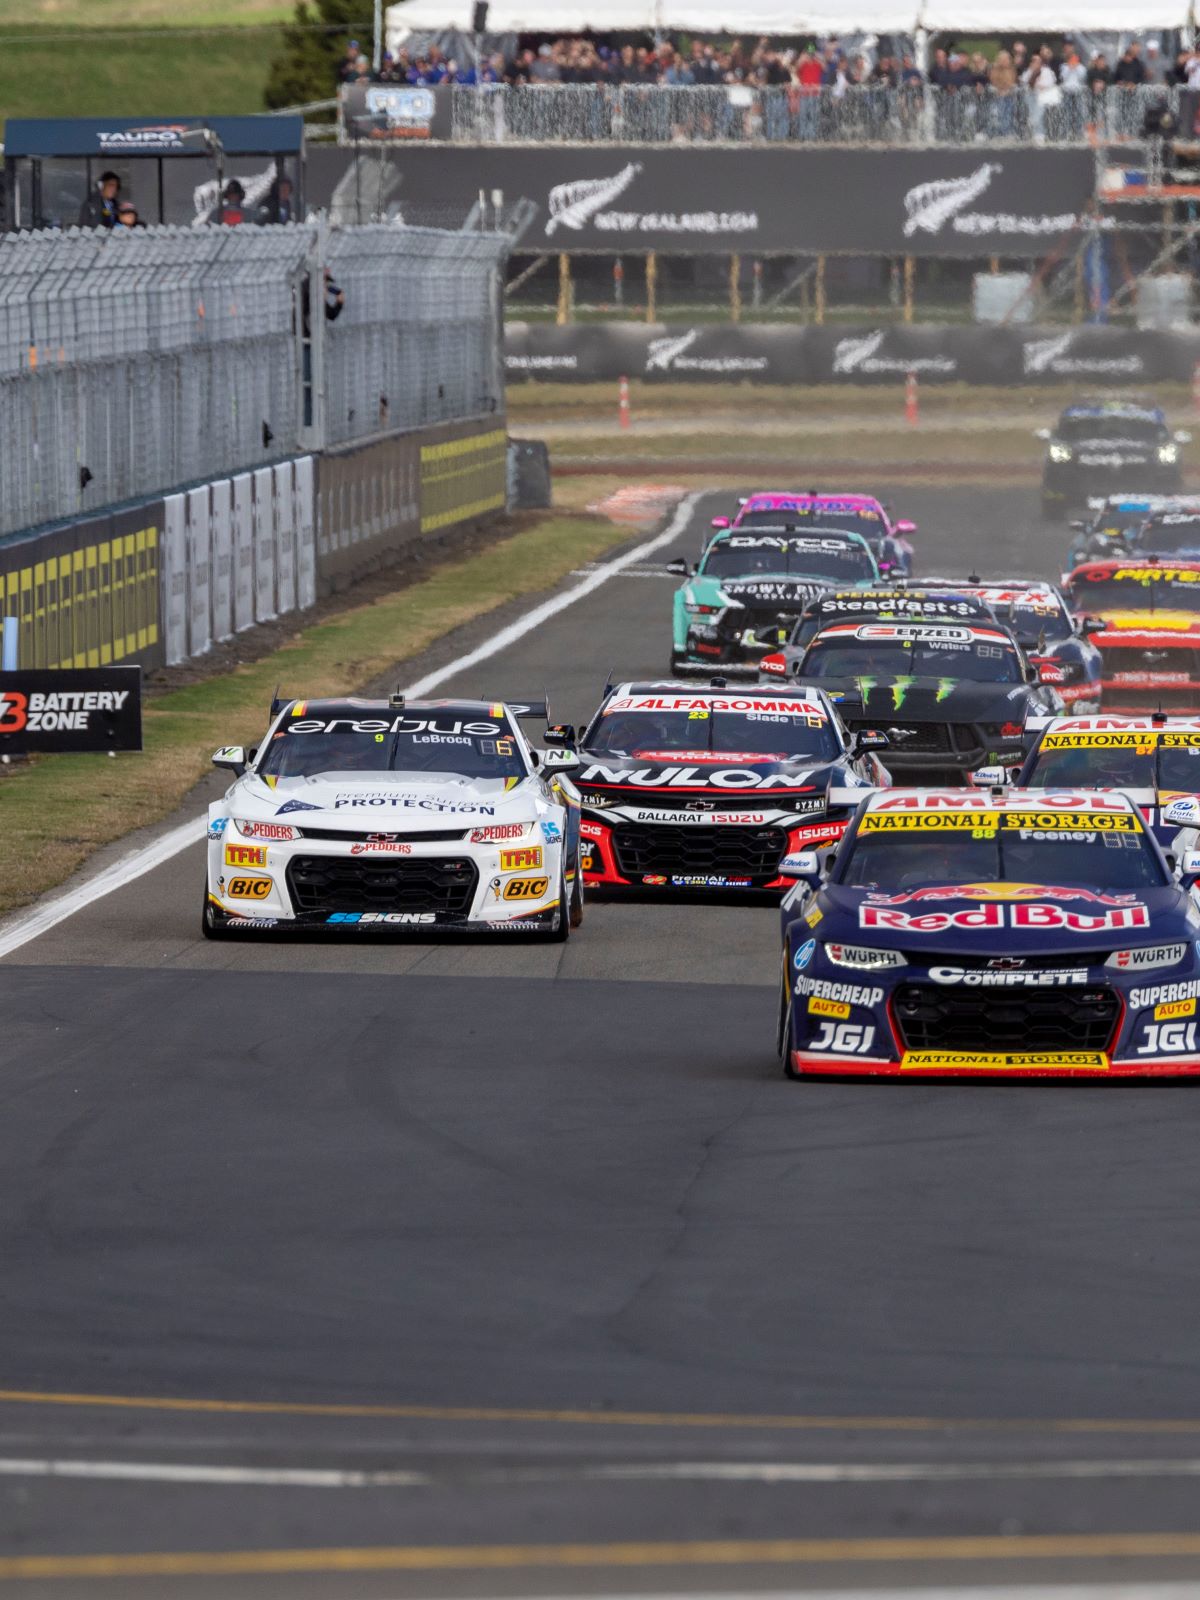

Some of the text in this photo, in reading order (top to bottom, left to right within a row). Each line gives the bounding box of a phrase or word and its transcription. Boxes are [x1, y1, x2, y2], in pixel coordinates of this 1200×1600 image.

[729, 537, 848, 549] DAYCO
[822, 600, 946, 613] Steadfast
[897, 627, 962, 638] ENZED
[929, 641, 970, 652] Waters
[28, 691, 130, 711] BATTERY
[634, 699, 823, 715] ALFAGOMMA
[25, 711, 91, 732] ZONE
[688, 711, 788, 723] 23 Slade
[288, 716, 500, 736] erebus
[374, 734, 472, 748] 9 LeBrocq
[1045, 735, 1151, 748] NATIONAL
[582, 766, 815, 788] NULON
[335, 799, 494, 815] PROTECTION
[876, 795, 1127, 810] AMPOL
[637, 811, 764, 823] BALLARAT ISUZU
[863, 812, 1130, 832] NATIONAL STORAGE
[254, 823, 293, 840] PEDDERS
[484, 824, 523, 840] PEDDERS
[799, 826, 840, 839] ISUZU
[972, 829, 1097, 843] 88 Feeney
[227, 846, 261, 863] TFH
[365, 843, 412, 854] PEDDERS
[503, 850, 537, 867] TFH
[859, 904, 1151, 932] Red Bull
[844, 947, 898, 966] WÜRTH
[1132, 945, 1183, 964] WÜRTH
[928, 966, 1088, 986] COMPLETE
[794, 974, 884, 1008] SUPERCHEAP
[813, 1001, 846, 1014] AUTO
[1159, 1002, 1192, 1016] AUTO
[808, 1022, 875, 1053] JGI
[1137, 1022, 1197, 1054] JGI
[908, 1054, 1099, 1066] NATIONAL STORAGE
